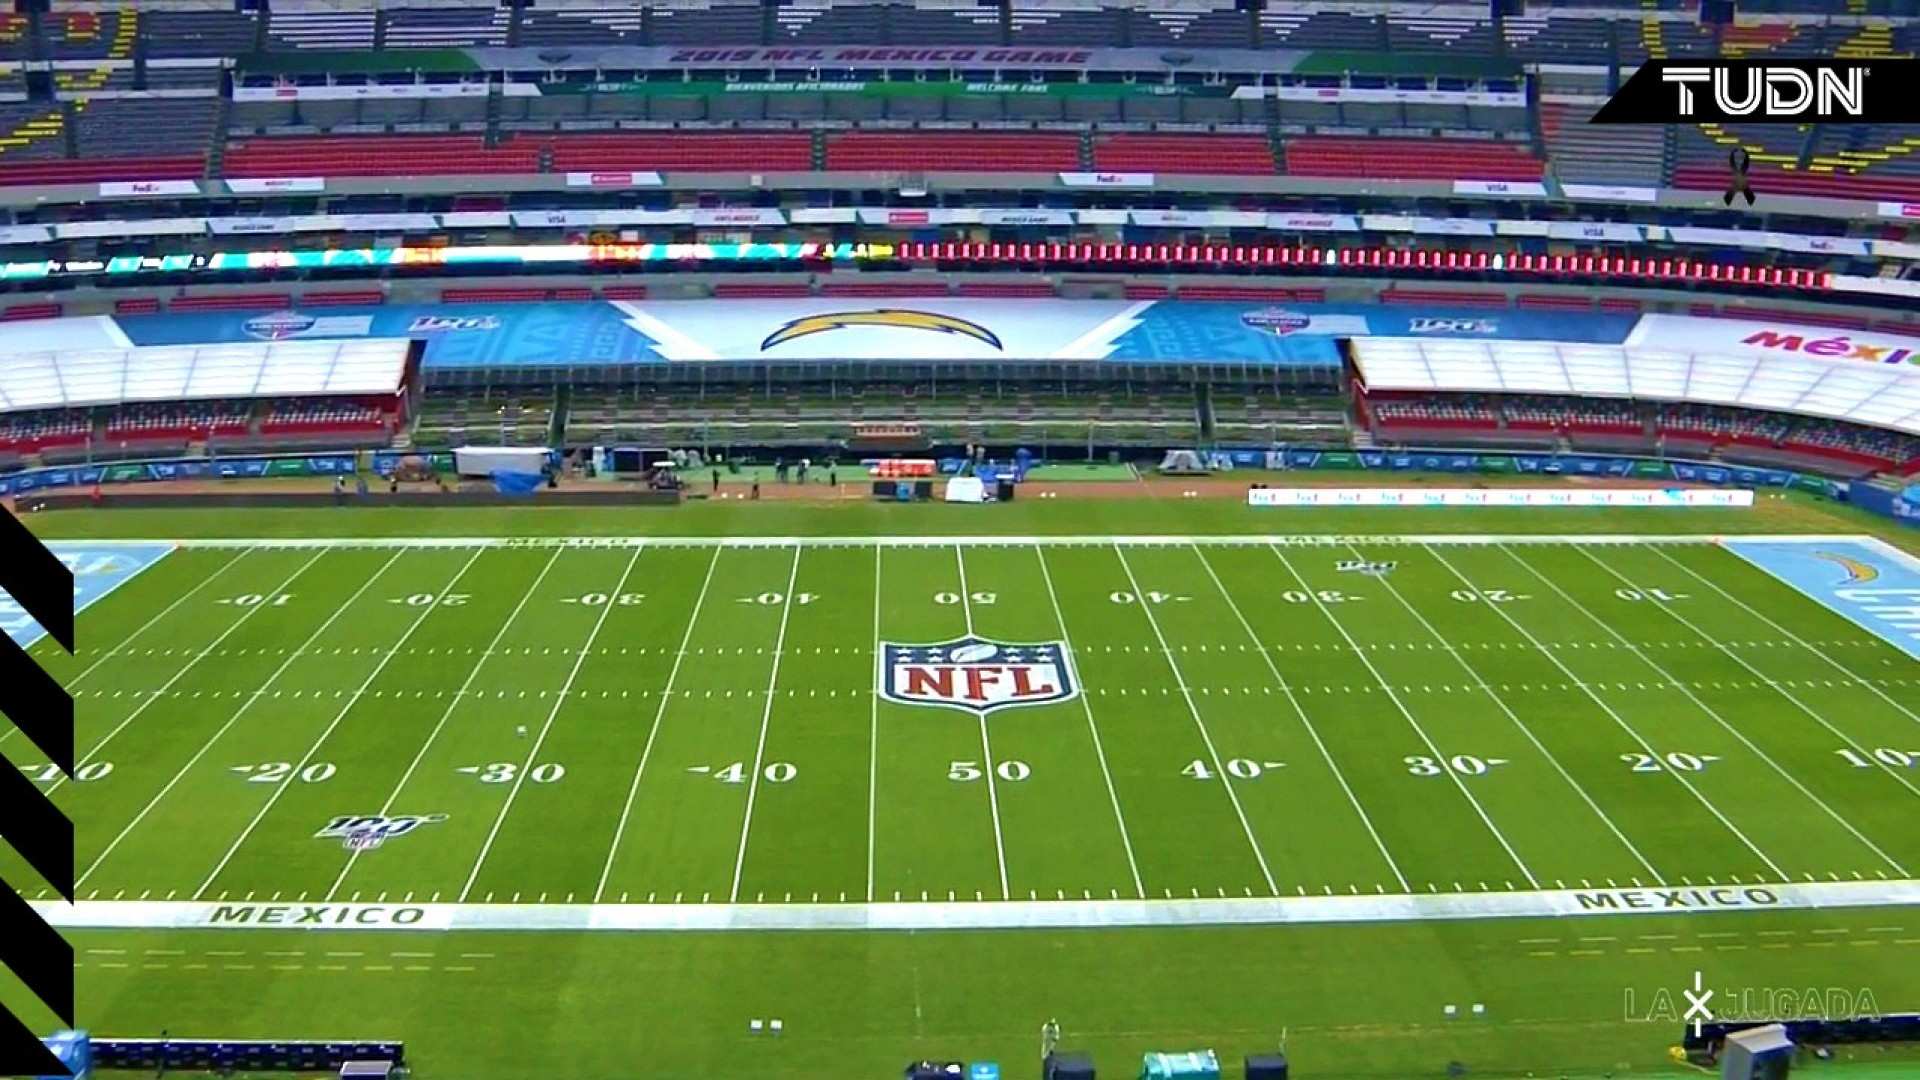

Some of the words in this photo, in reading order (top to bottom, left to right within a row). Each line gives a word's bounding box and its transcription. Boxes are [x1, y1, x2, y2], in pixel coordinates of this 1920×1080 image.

[761, 50, 825, 61] NFL
[834, 50, 977, 62] MEXICO
[982, 51, 1092, 63] GAME
[903, 666, 1054, 703] NFL
[1180, 757, 1262, 780] 40
[1404, 753, 1488, 777] 30
[1619, 751, 1704, 773] 20
[1835, 747, 1914, 768] 10
[247, 761, 337, 783] 20
[480, 761, 566, 783] 30
[713, 762, 797, 784] 40
[947, 760, 1031, 782] 50
[1574, 887, 1778, 911] MEXICO
[208, 905, 425, 925] MEXICO
